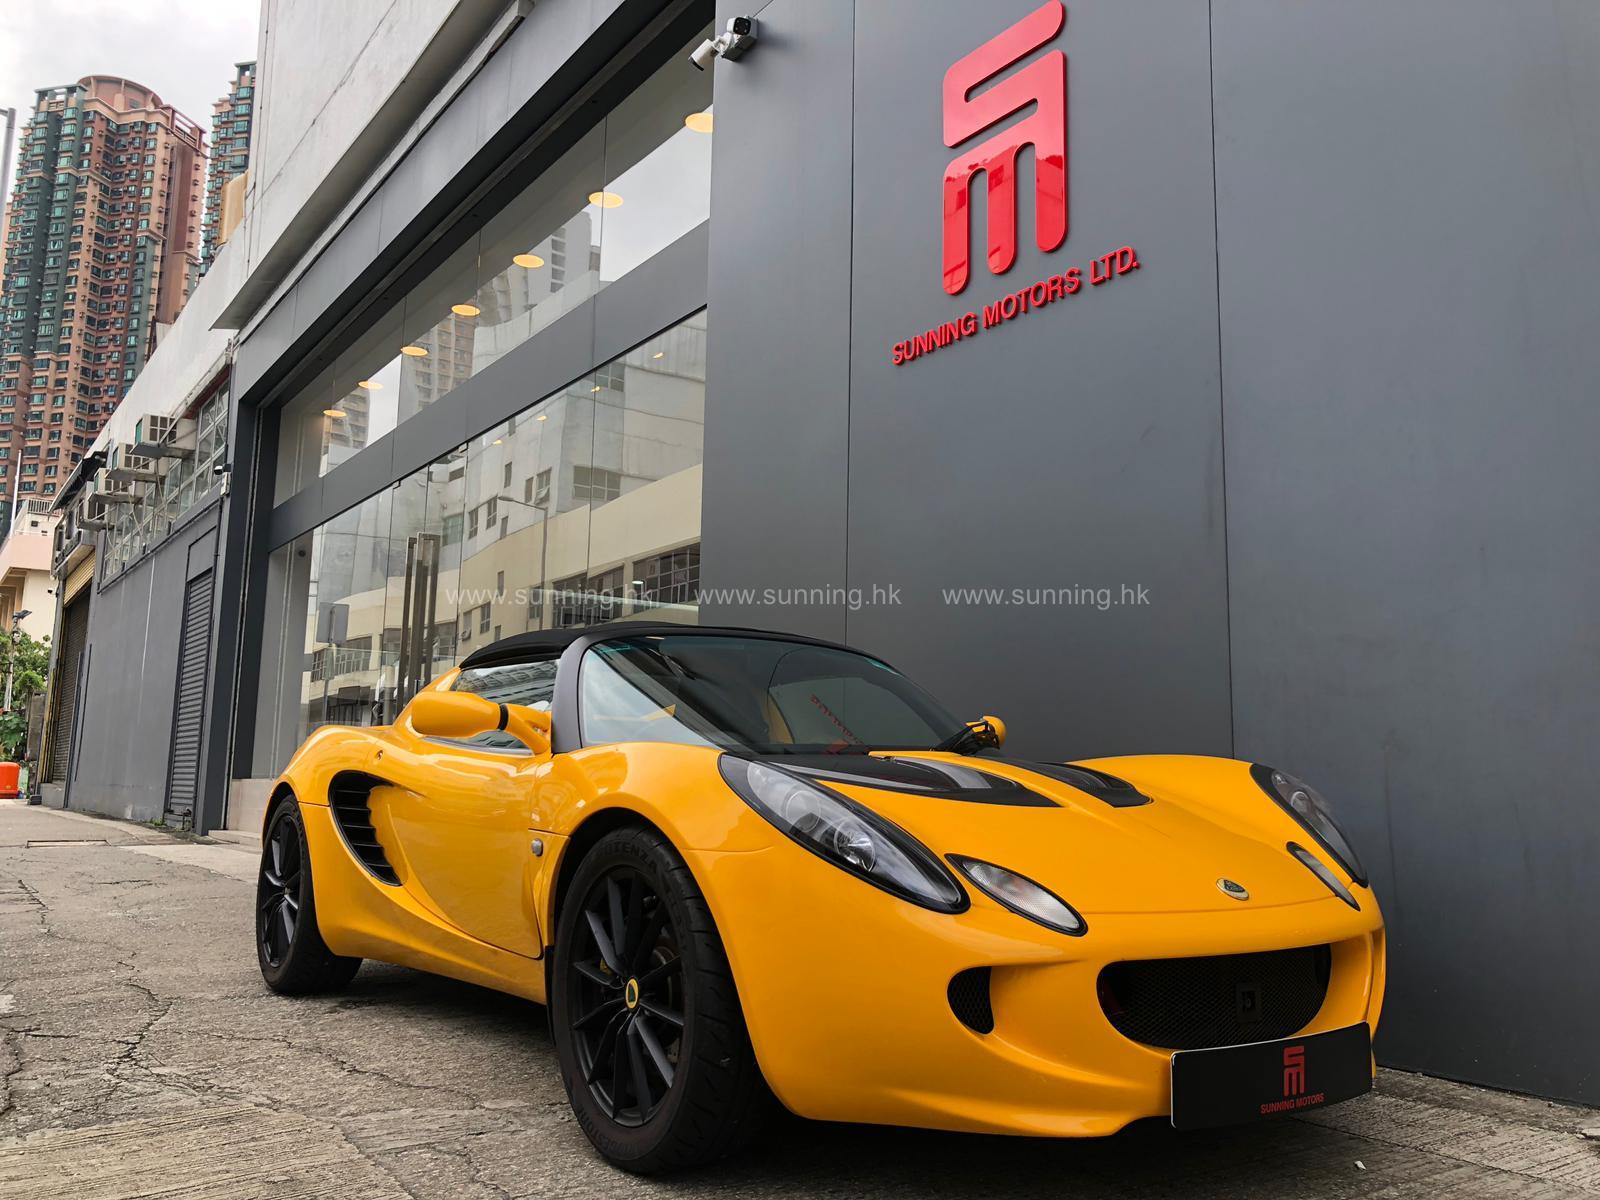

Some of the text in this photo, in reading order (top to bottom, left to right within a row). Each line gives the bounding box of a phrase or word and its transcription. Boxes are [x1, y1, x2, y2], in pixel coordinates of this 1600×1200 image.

[893, 245, 1140, 365] SUNNING MOTORS LTD.
[1260, 1092, 1325, 1114] SUNNING MOTORS
